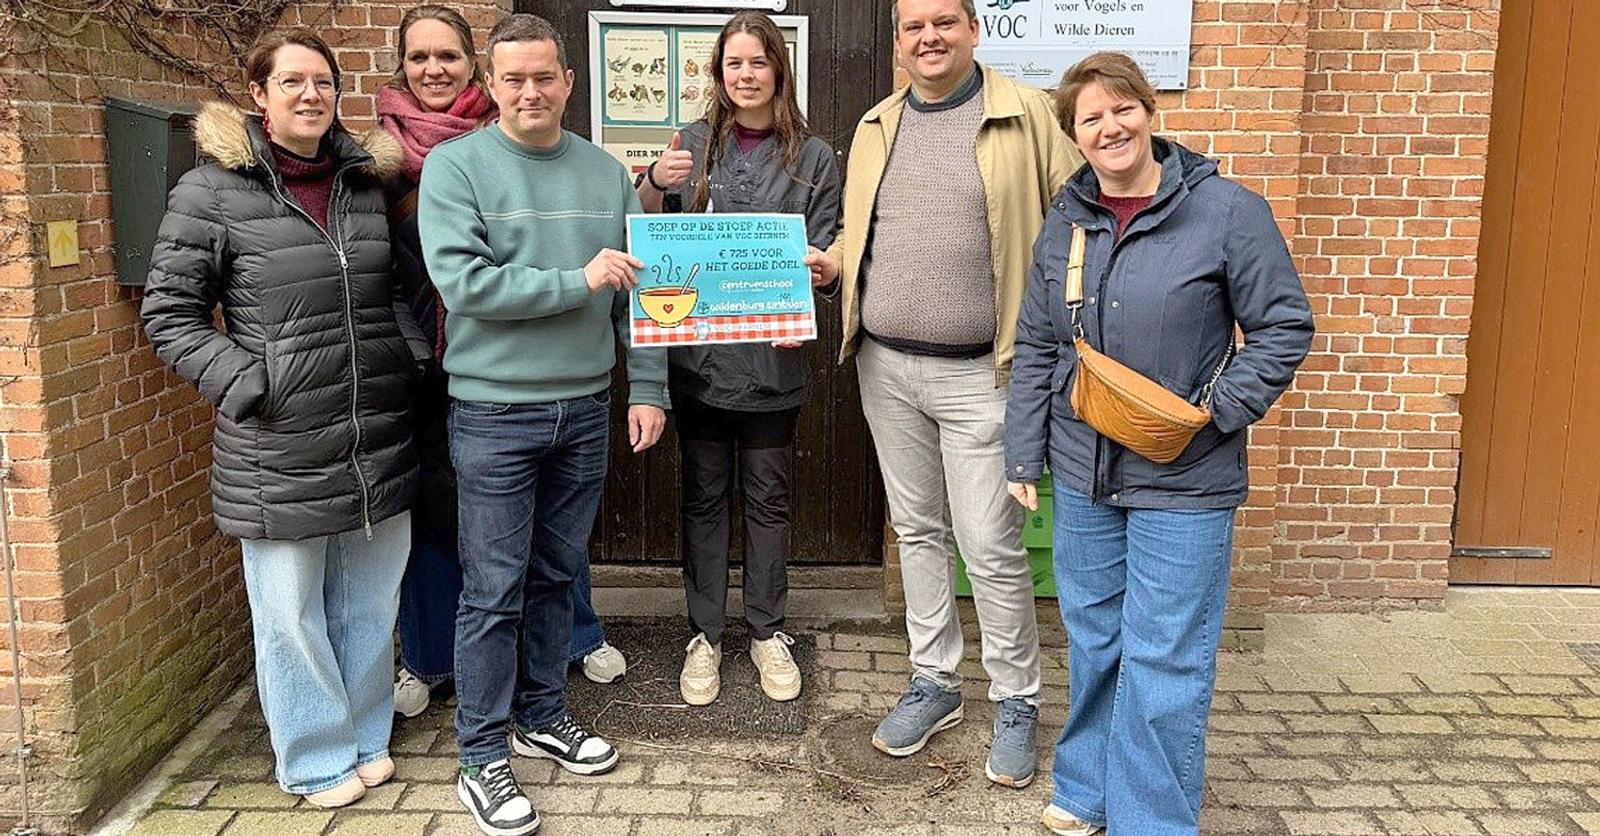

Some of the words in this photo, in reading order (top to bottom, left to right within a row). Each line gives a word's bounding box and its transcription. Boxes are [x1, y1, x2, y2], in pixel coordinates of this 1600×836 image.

[1054, 3, 1080, 11] voor
[1085, 0, 1127, 14] Vogels
[1130, 3, 1144, 11] en
[982, 14, 1028, 39] VOC
[1054, 23, 1090, 36] Wilde
[1094, 23, 1135, 36] Dieren
[647, 222, 678, 233] SOEP
[680, 222, 697, 232] OP
[700, 222, 715, 232] DE
[717, 221, 754, 232] STOEP
[756, 221, 789, 231] ACTIE
[650, 233, 667, 241] TEN
[669, 233, 713, 241] VOORDELE
[714, 232, 733, 240] VAN
[735, 232, 752, 240] VOC
[718, 249, 726, 259] €
[729, 248, 748, 258] 725
[751, 248, 783, 258] VOOR
[705, 262, 729, 272] HET
[731, 261, 768, 271] GOEDE
[771, 260, 800, 270] DOEL
